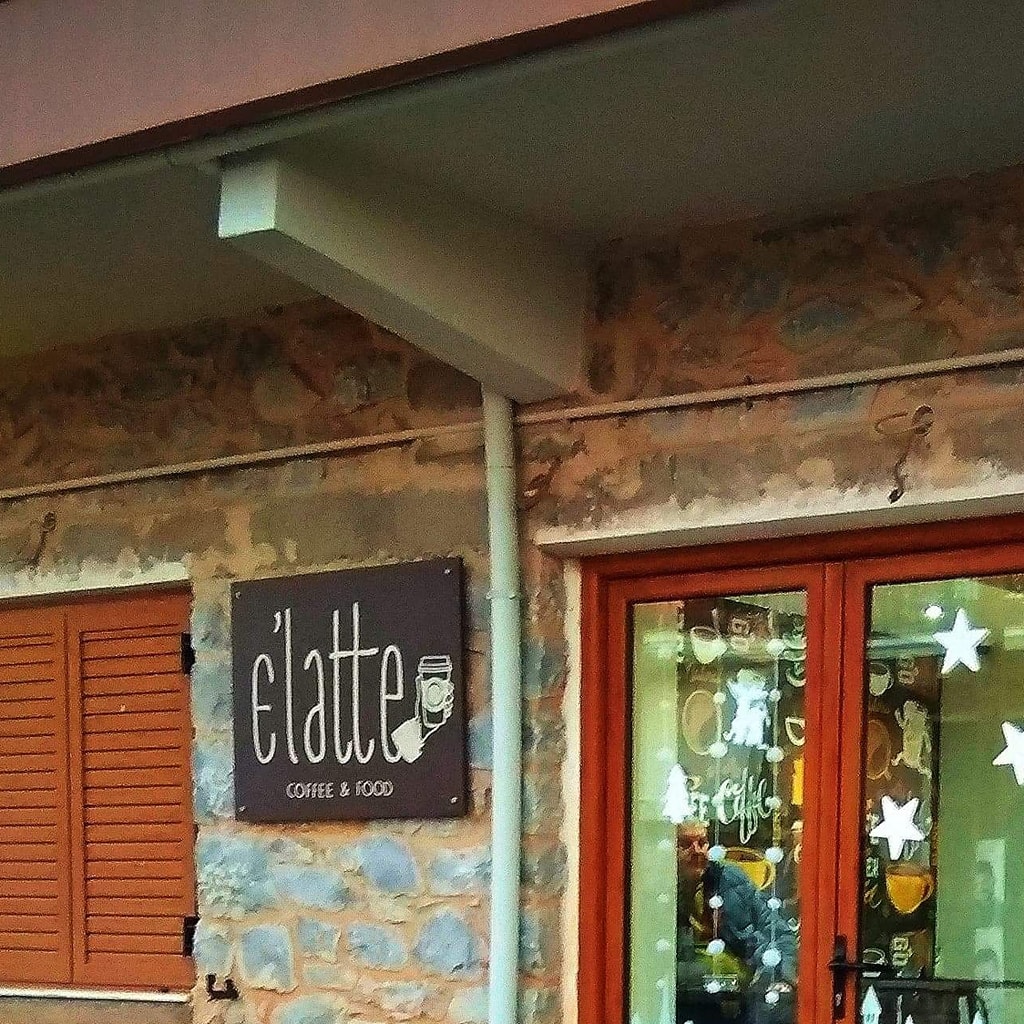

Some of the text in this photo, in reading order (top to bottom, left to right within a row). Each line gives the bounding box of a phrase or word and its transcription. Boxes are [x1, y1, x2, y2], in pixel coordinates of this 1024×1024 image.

[285, 779, 394, 798] COFFEE & FOOD
